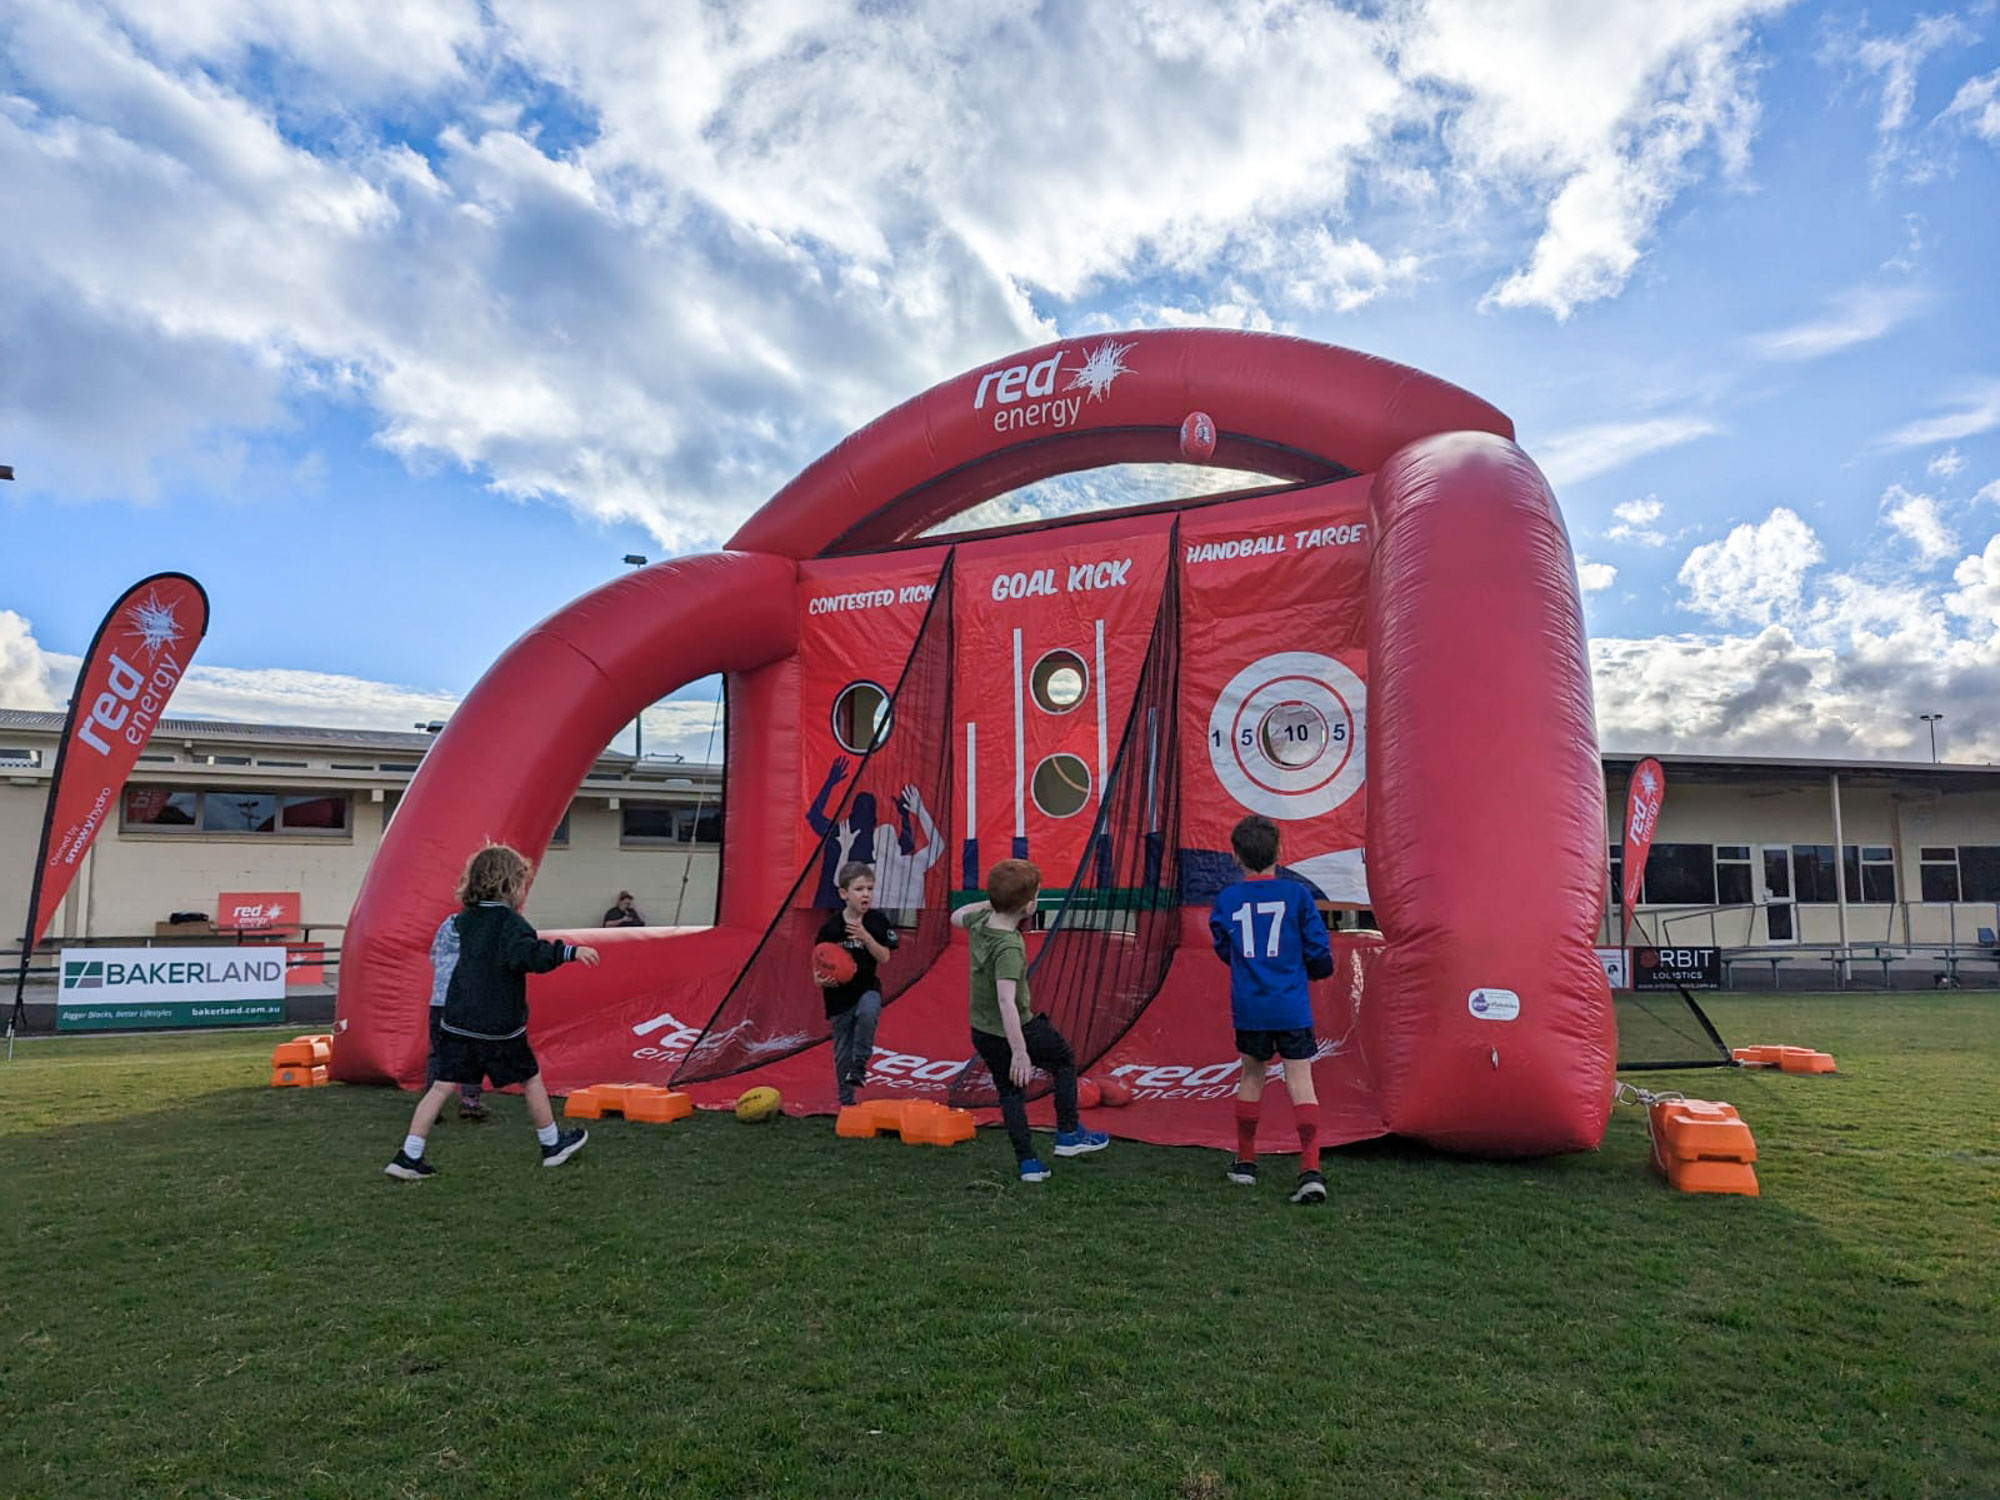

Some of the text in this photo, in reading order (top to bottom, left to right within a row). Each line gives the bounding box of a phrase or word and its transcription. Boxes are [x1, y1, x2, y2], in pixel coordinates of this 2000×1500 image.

[974, 351, 1063, 409] red
[993, 396, 1080, 432] energy
[1186, 523, 1367, 563] HANDBALL TARGE
[991, 557, 1132, 602] GOAL KICK
[808, 589, 895, 615] CONTESTED
[78, 653, 144, 756] red
[125, 652, 181, 745] energy
[1211, 723, 1346, 747] 1 5 10 5
[64, 787, 111, 865] snowyhydro
[1630, 795, 1647, 846] red
[1642, 798, 1659, 842] energy
[233, 904, 263, 918] red
[1232, 901, 1285, 958] 17
[106, 961, 281, 985] BAKERLAND
[192, 1006, 281, 1016] bakerland.com.au
[1110, 1056, 1242, 1088] red
